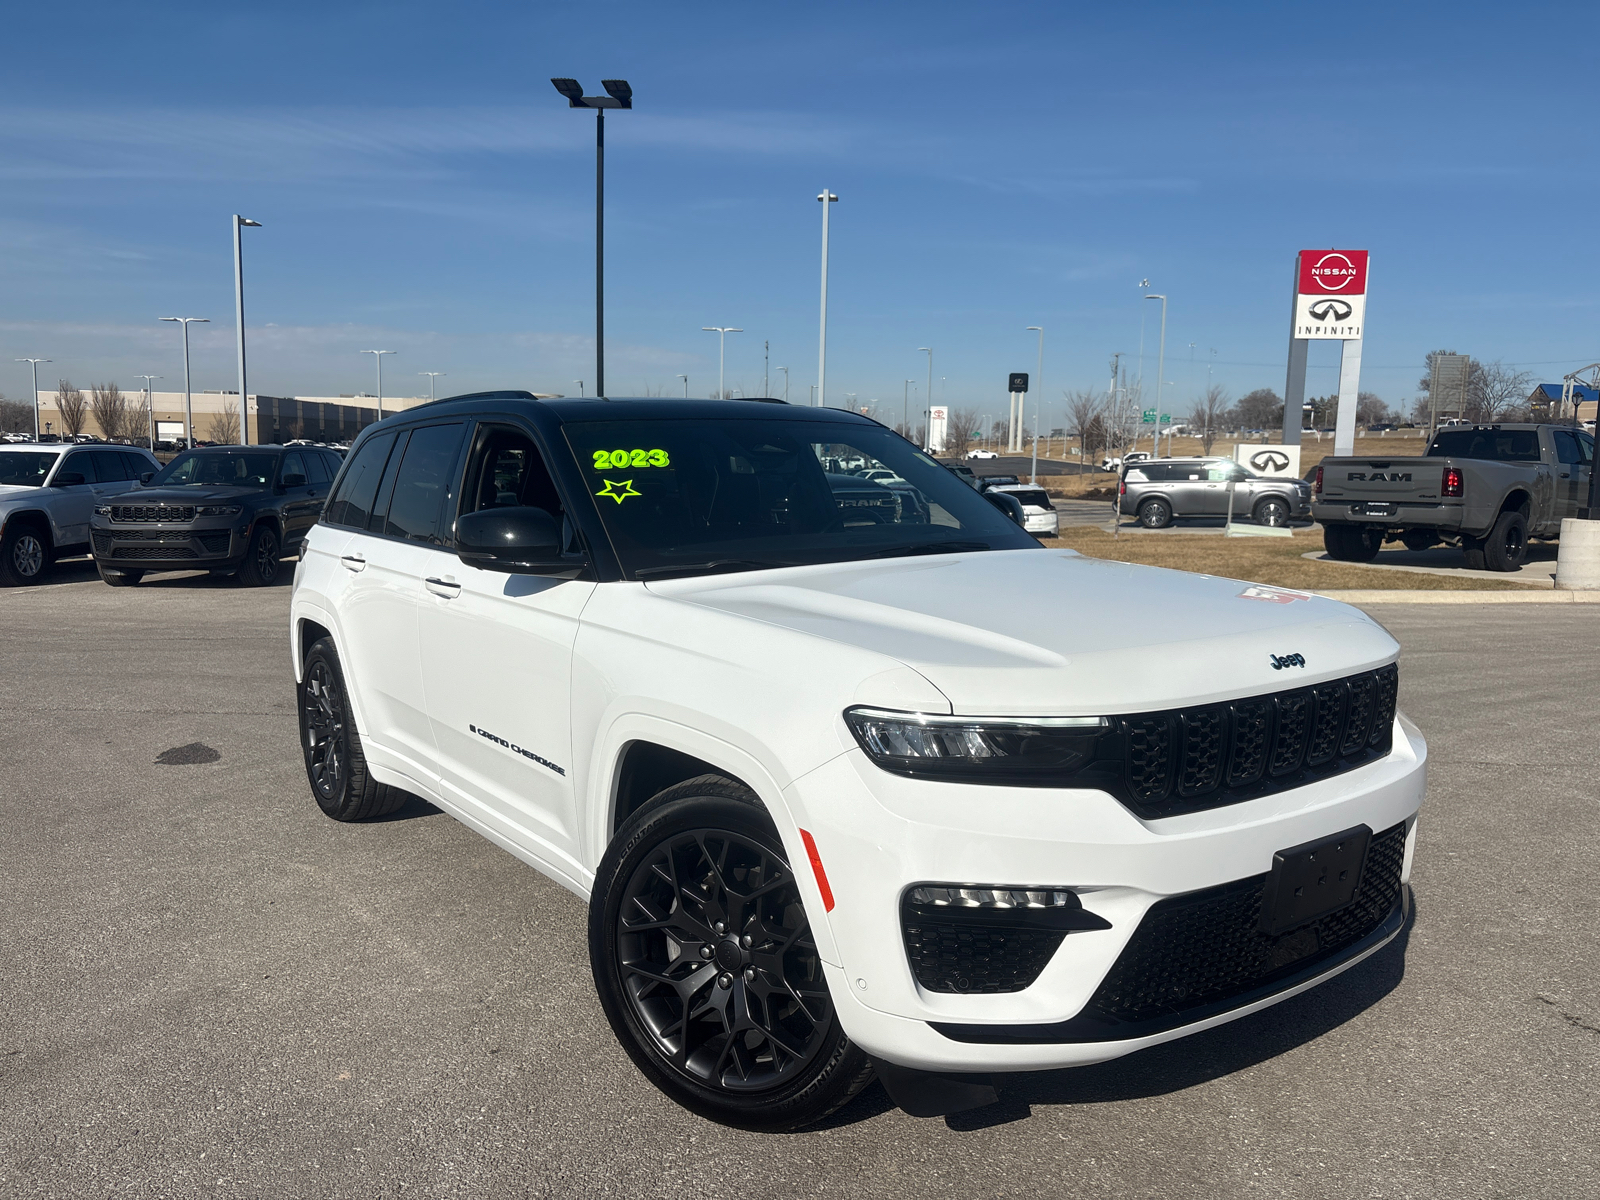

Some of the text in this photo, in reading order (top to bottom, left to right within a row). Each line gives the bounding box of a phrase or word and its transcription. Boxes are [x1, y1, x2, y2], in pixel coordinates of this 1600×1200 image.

[1311, 268, 1357, 276] NISSAN
[1298, 325, 1360, 336] INFINITI
[592, 448, 670, 470] 2023
[1346, 471, 1413, 483] RAM
[1269, 652, 1306, 671] Jeep
[477, 727, 567, 777] GRAND CHEROKEE
